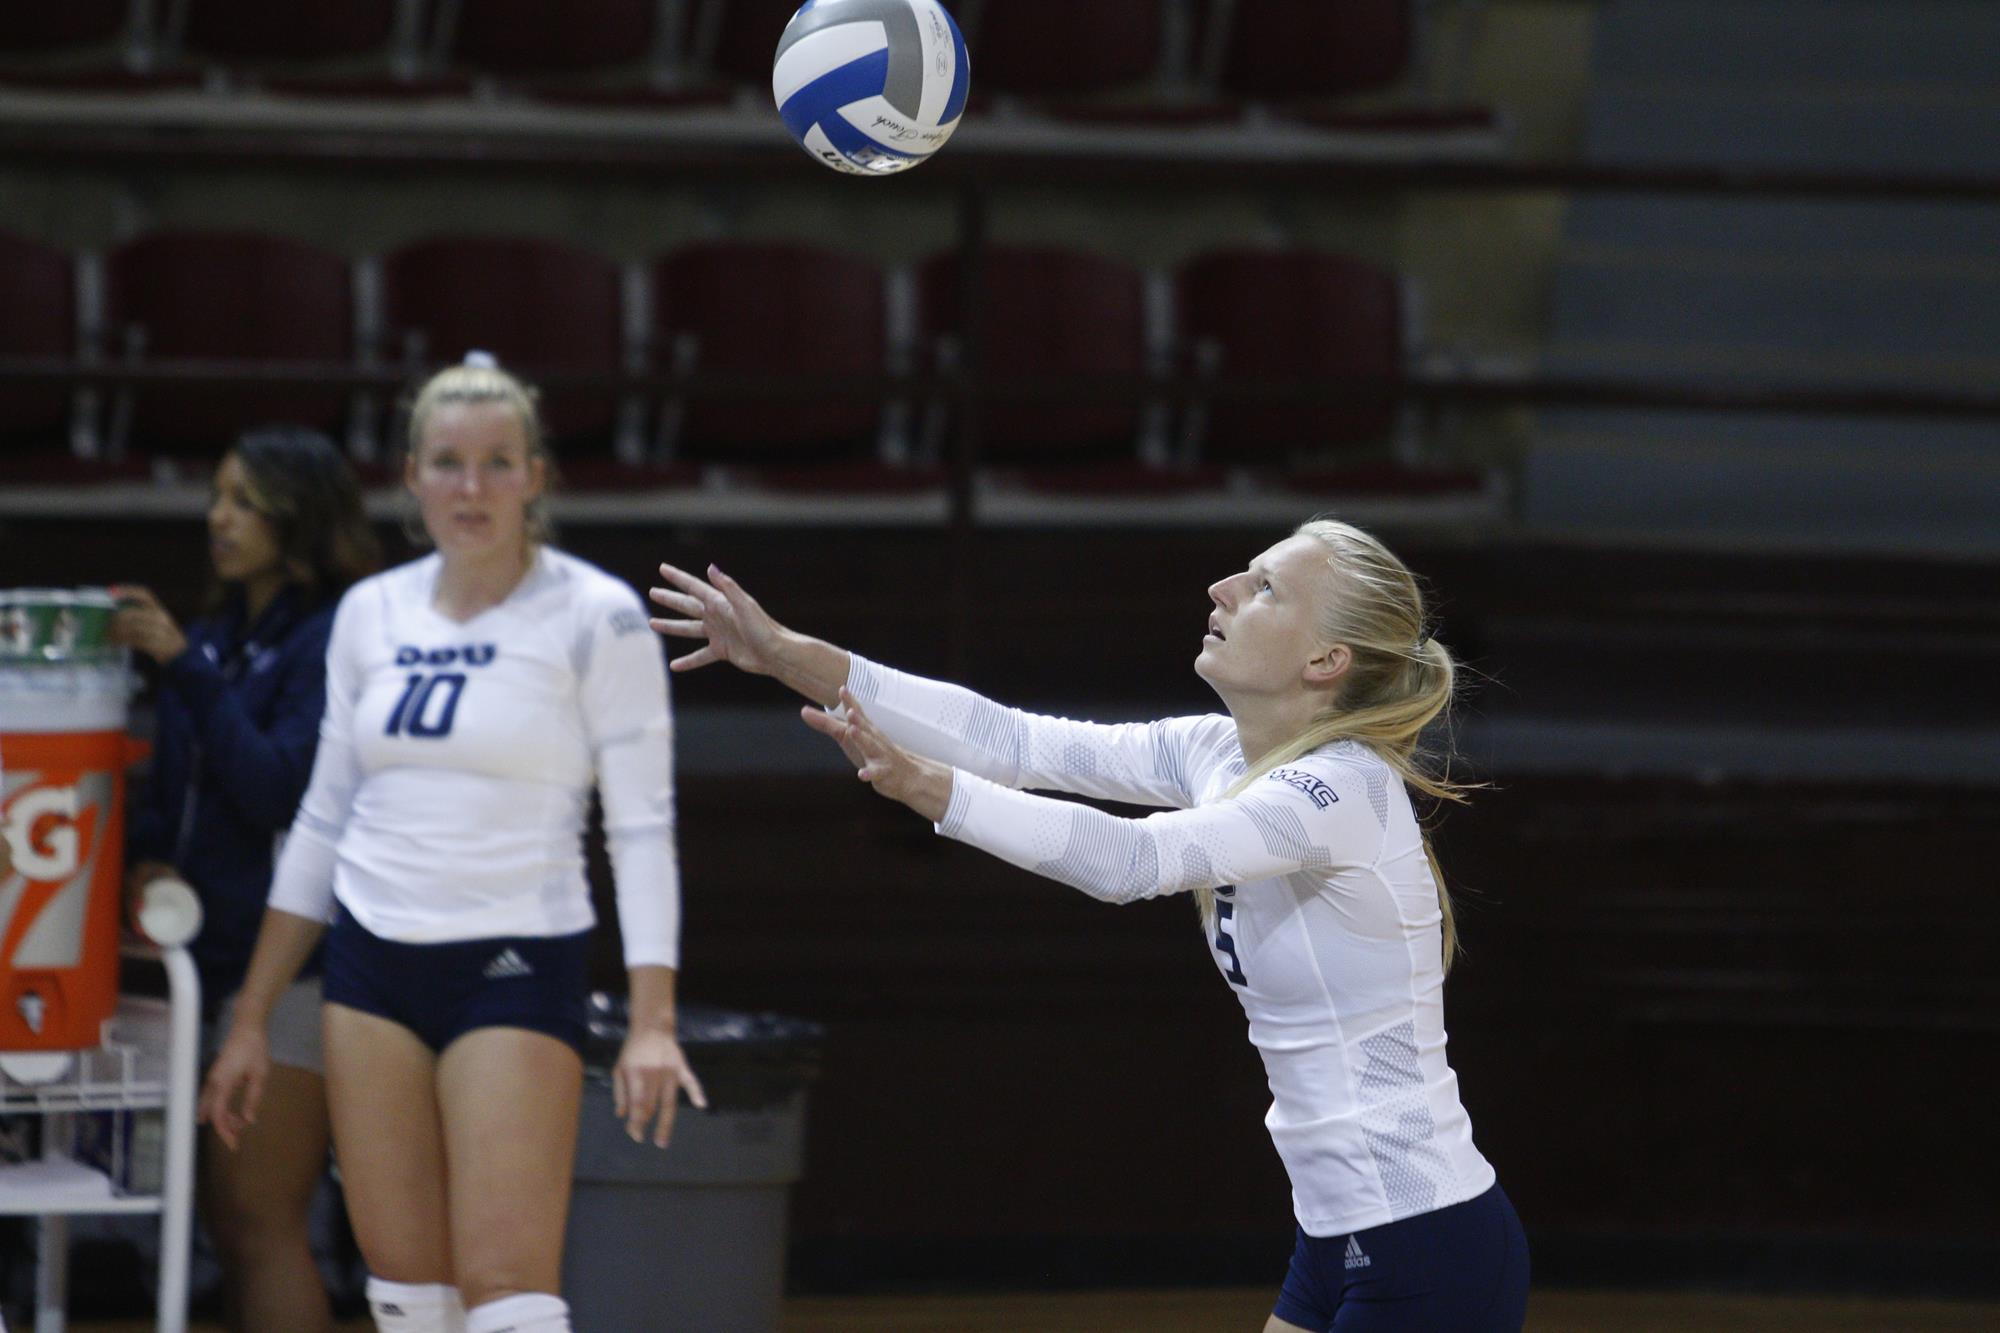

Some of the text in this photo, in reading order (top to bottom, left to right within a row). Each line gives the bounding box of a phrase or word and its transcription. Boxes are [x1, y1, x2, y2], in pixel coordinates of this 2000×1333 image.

[384, 673, 467, 738] 10
[1269, 768, 1340, 808] WAC
[4, 786, 78, 880] G
